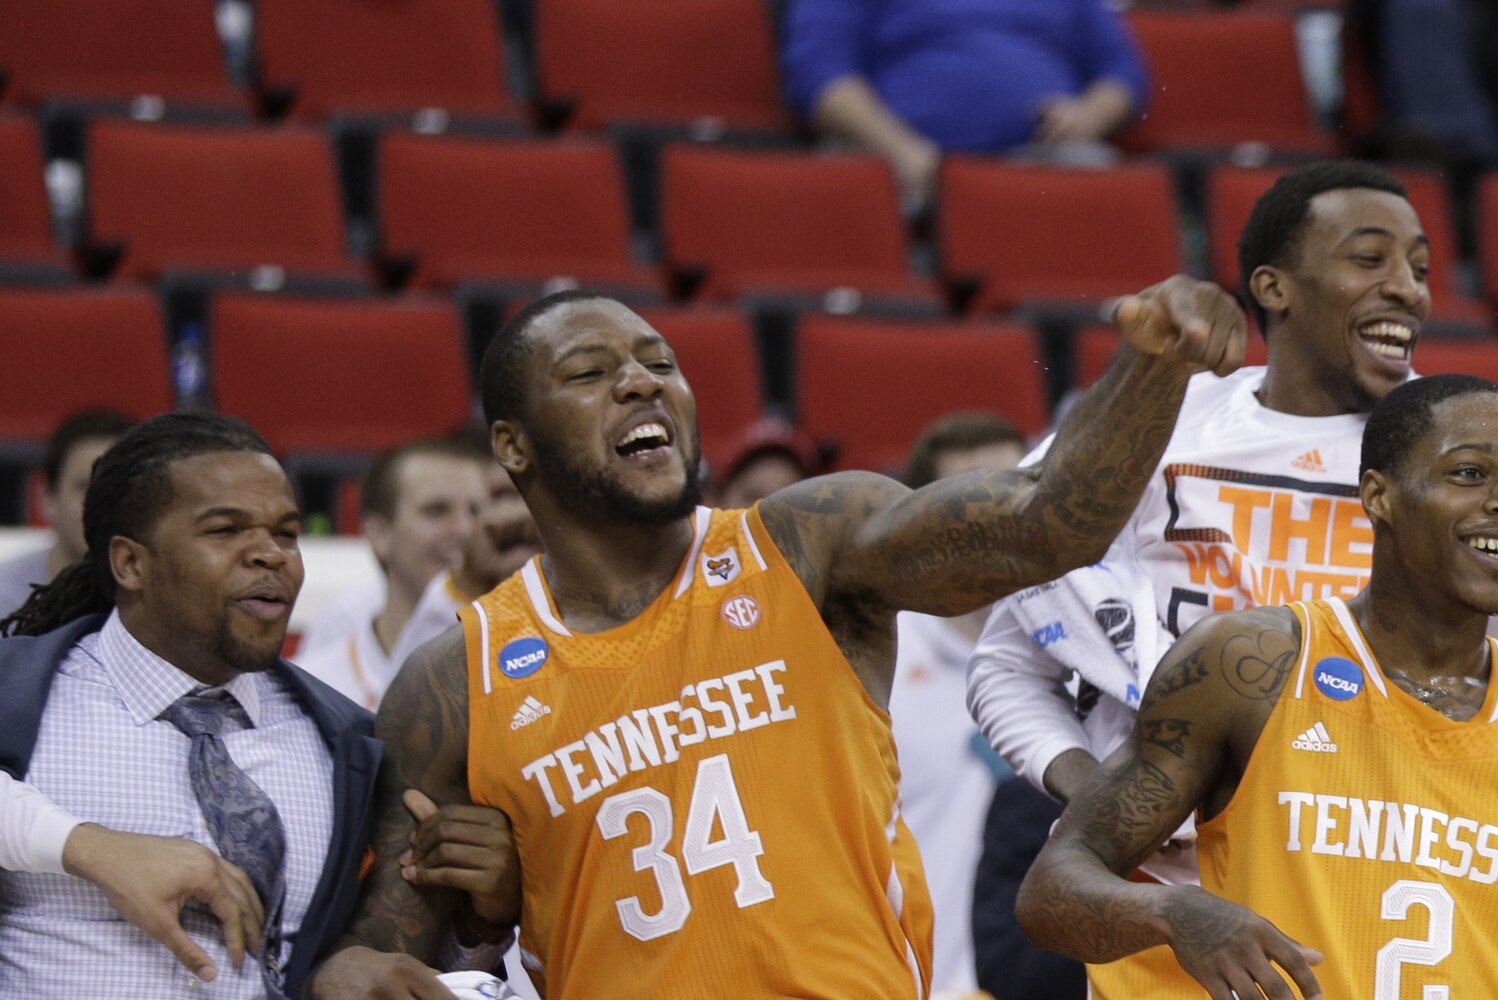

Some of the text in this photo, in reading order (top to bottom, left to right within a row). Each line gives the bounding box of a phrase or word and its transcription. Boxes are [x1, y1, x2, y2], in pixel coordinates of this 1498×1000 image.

[1218, 485, 1375, 570] THE
[724, 597, 759, 628] SEC
[506, 649, 546, 672] NCAA
[1317, 671, 1359, 695] NCAA
[510, 705, 552, 731] adidas
[520, 659, 797, 818] TENNESSEE
[1292, 740, 1338, 753] adidas
[595, 752, 776, 942] 34
